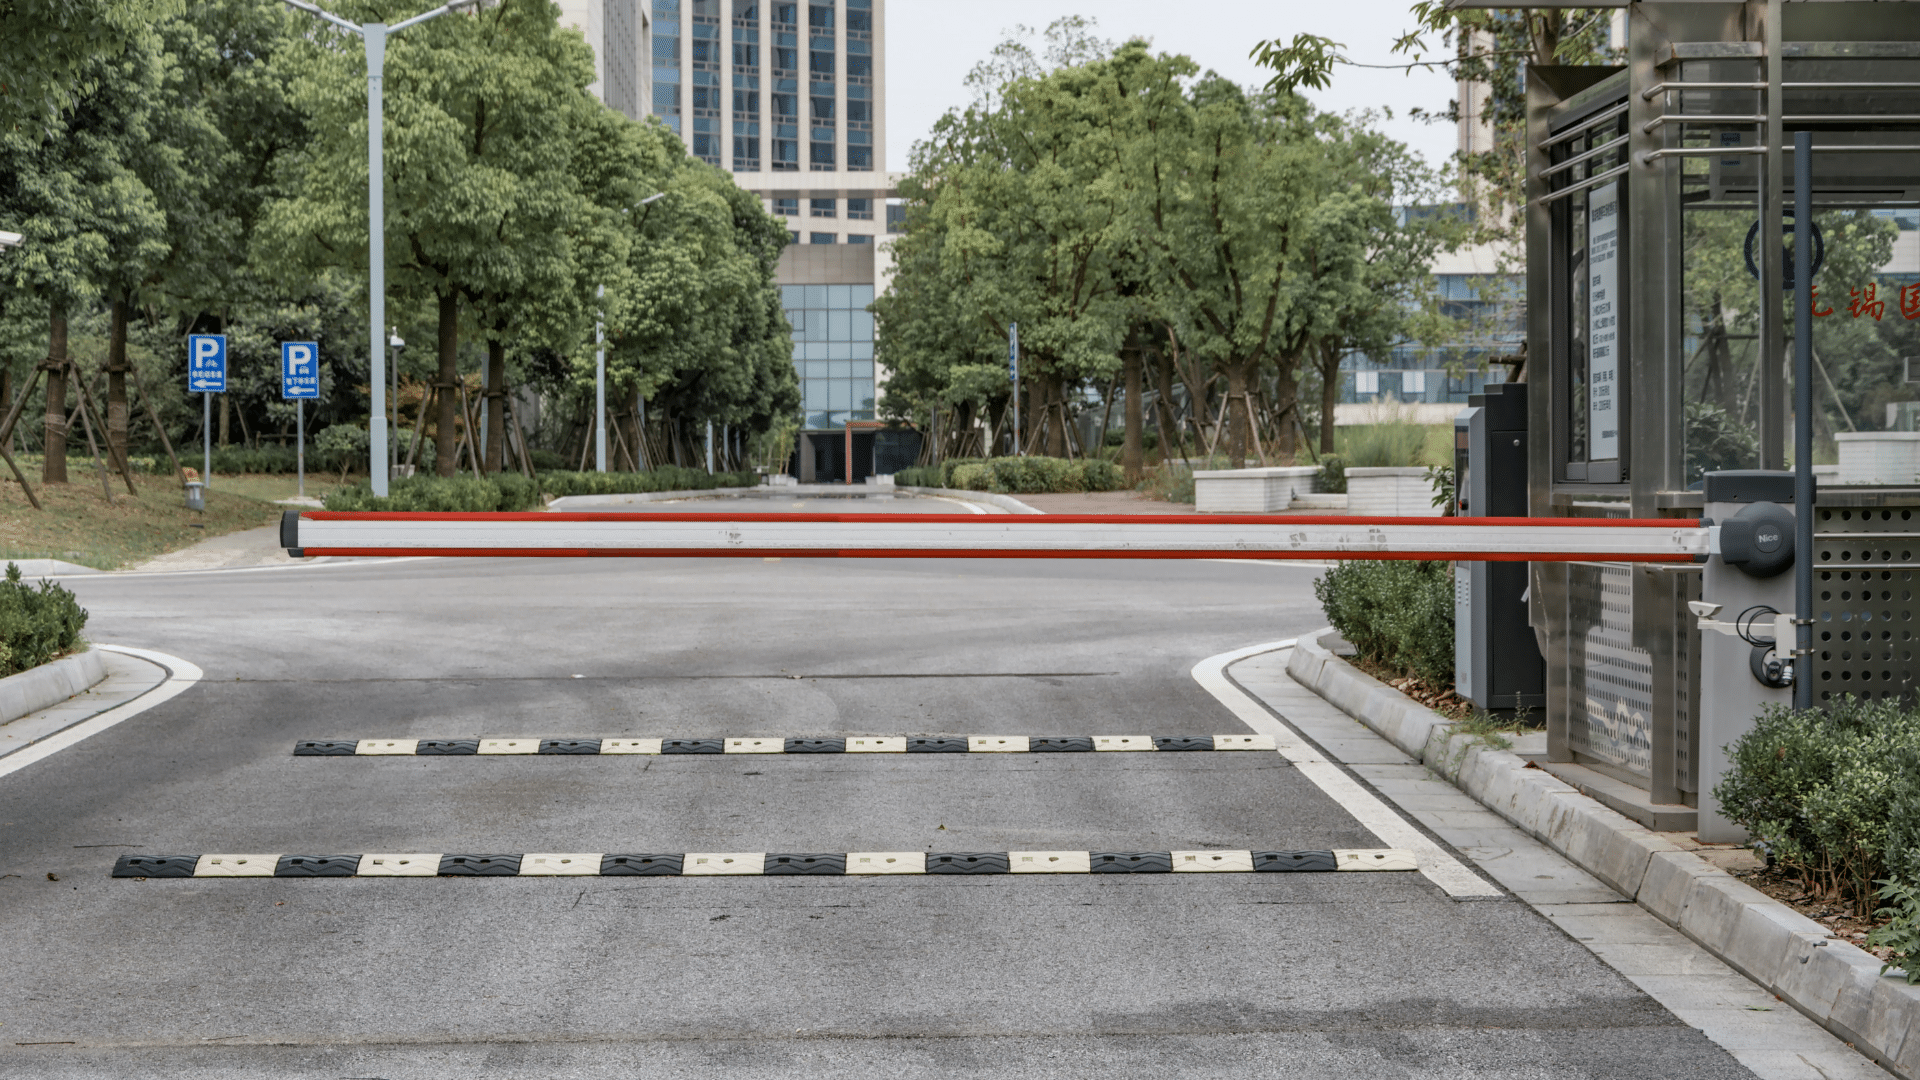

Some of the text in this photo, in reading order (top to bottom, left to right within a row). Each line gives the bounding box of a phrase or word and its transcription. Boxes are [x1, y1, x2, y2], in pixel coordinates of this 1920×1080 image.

[196, 338, 219, 368] P
[289, 345, 311, 375] P
[1758, 534, 1778, 543] Nice
